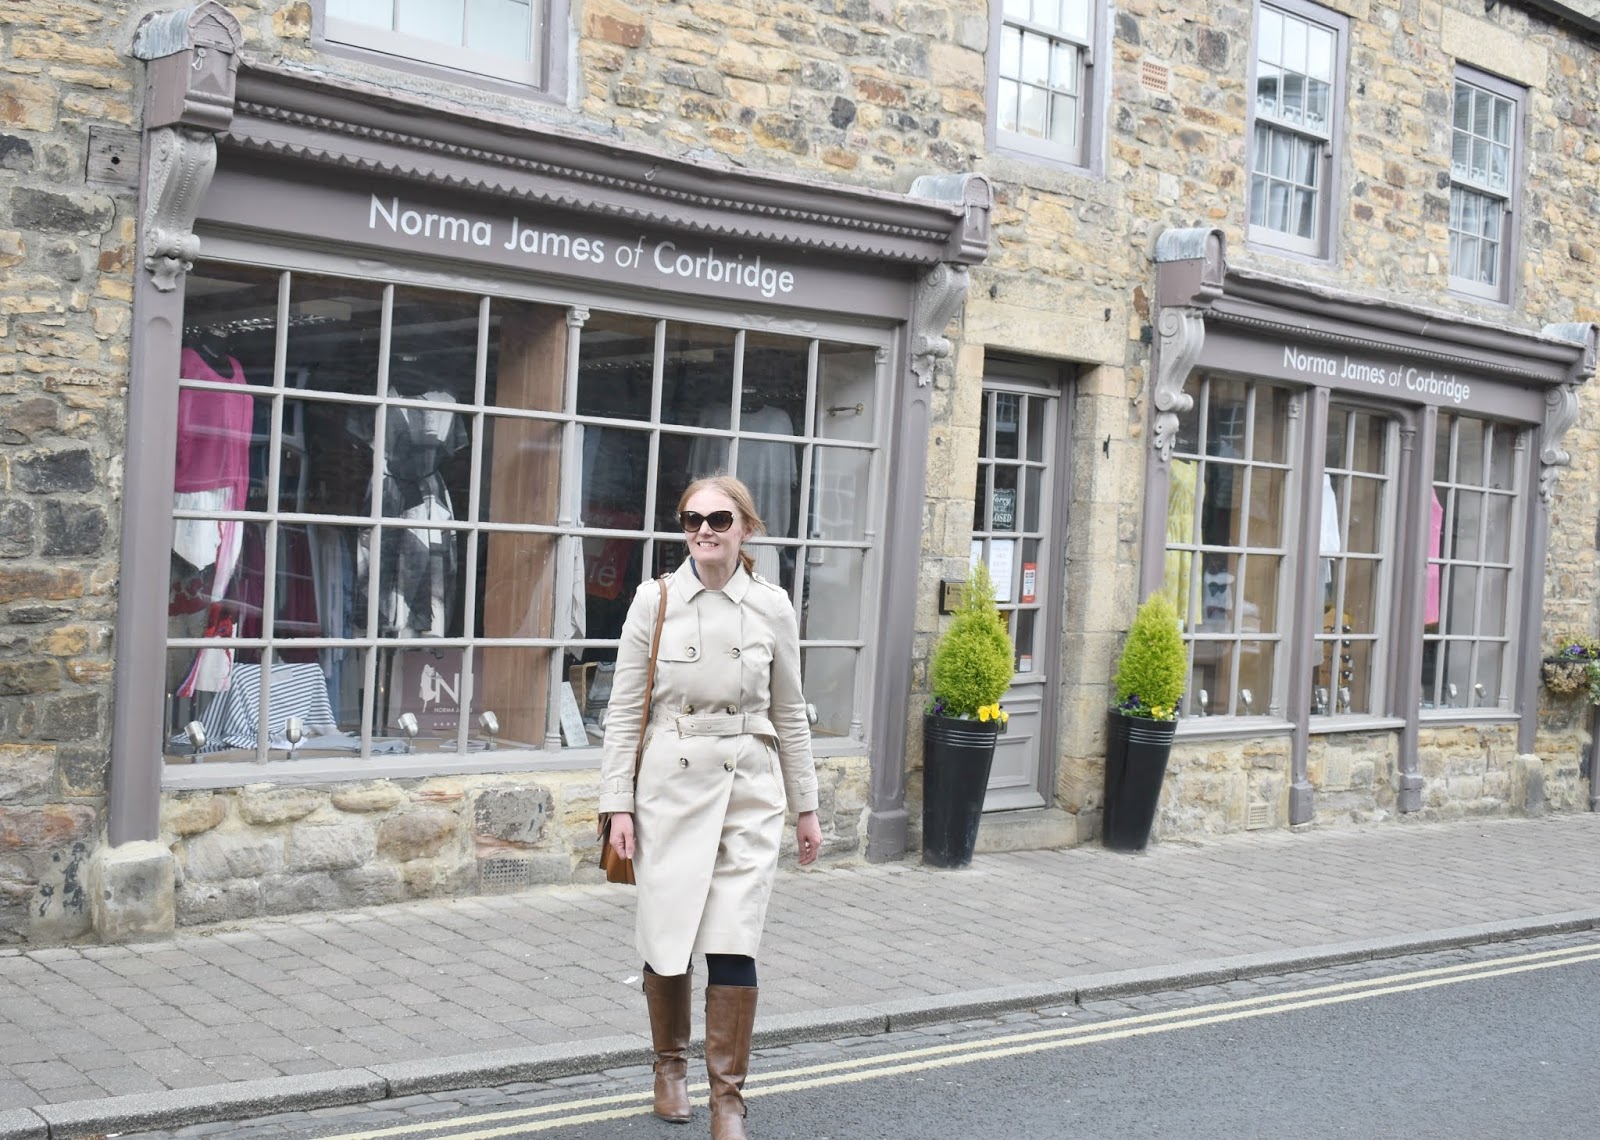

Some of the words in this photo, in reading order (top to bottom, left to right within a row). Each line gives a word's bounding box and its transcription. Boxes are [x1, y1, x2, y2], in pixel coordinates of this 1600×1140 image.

[368, 193, 492, 246] Norma
[504, 216, 605, 263] James
[615, 235, 647, 269] of
[653, 241, 795, 298] Corbridge
[1283, 345, 1337, 376] Norma
[1340, 356, 1385, 385] James
[1388, 365, 1404, 387] of
[1405, 368, 1471, 404] Corbridge
